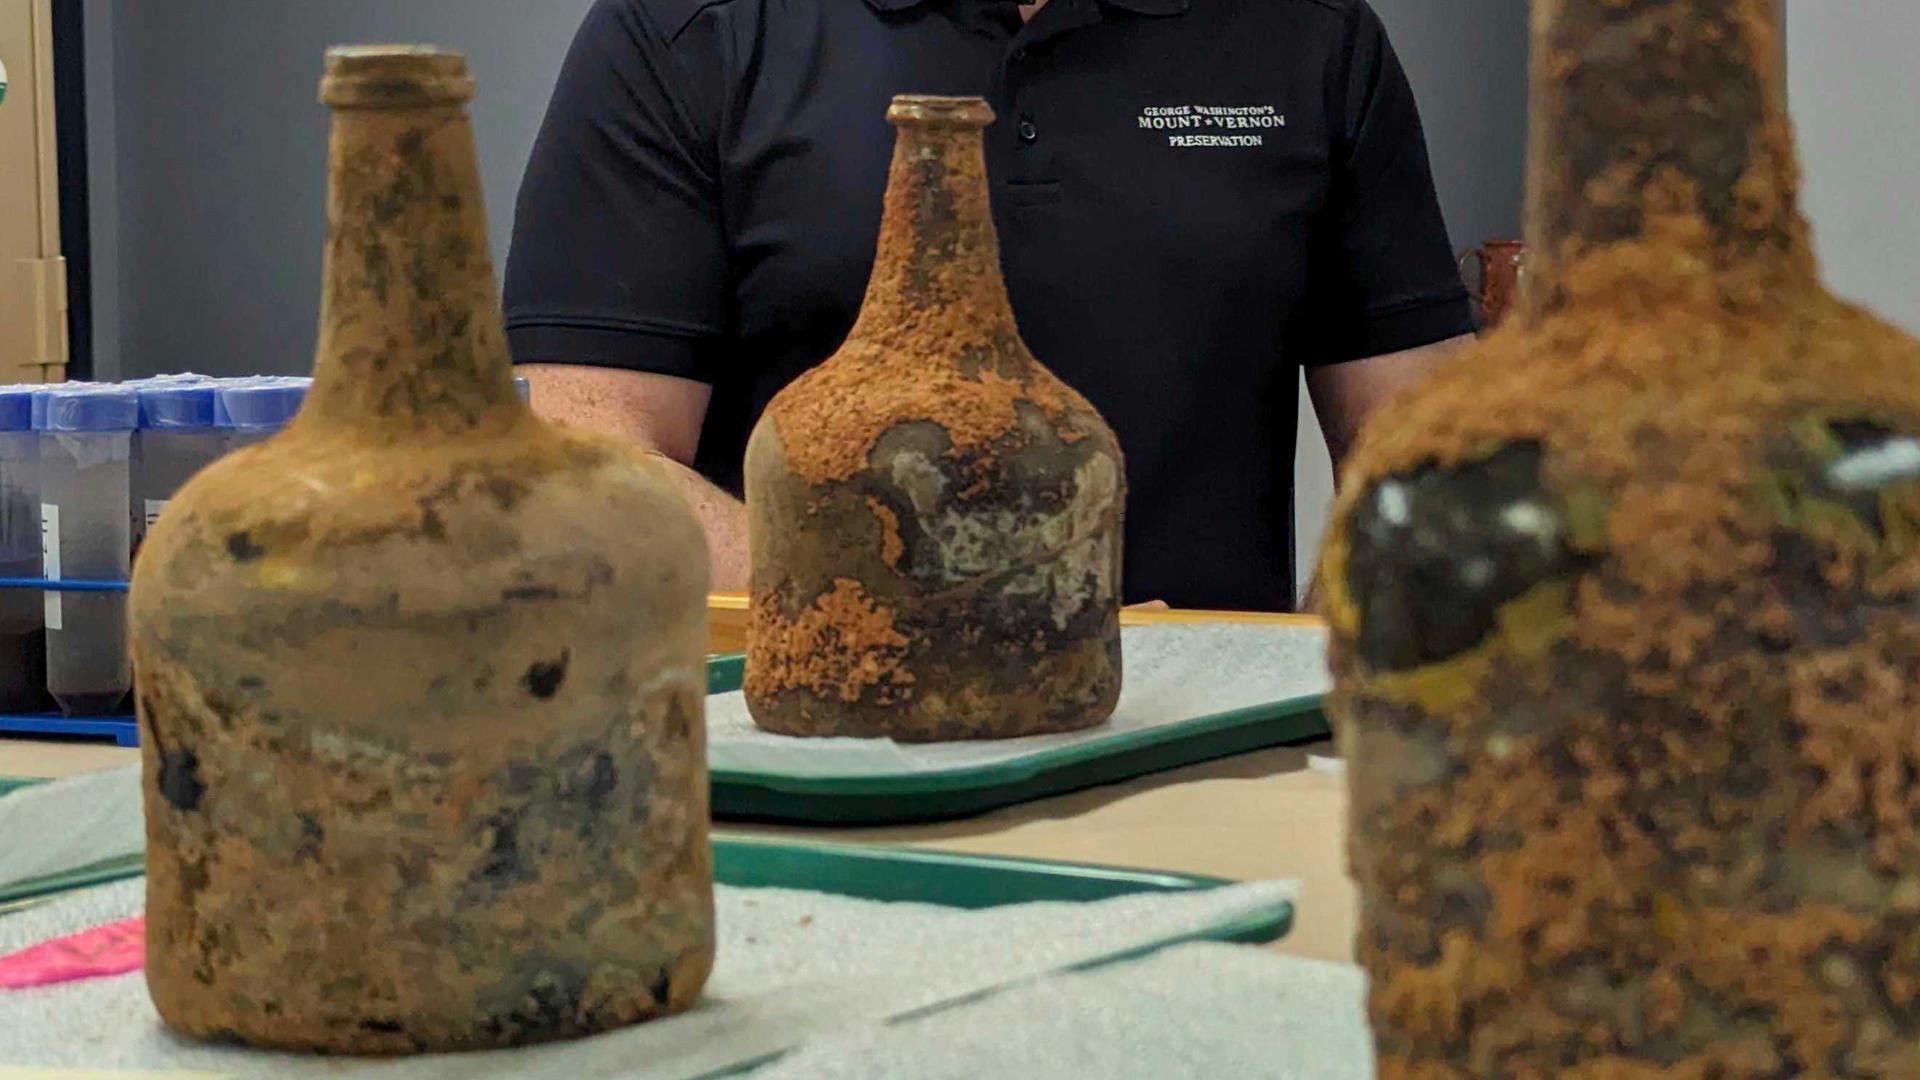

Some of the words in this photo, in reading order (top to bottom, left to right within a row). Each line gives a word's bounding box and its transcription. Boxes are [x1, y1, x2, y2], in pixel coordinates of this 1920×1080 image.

[1144, 106, 1191, 116] GEORGE
[1194, 105, 1275, 116] WASHINGTON'S
[1138, 116, 1202, 129] MOUNT
[1213, 115, 1285, 129] VERNON
[1168, 135, 1263, 147] PRESERVATION
